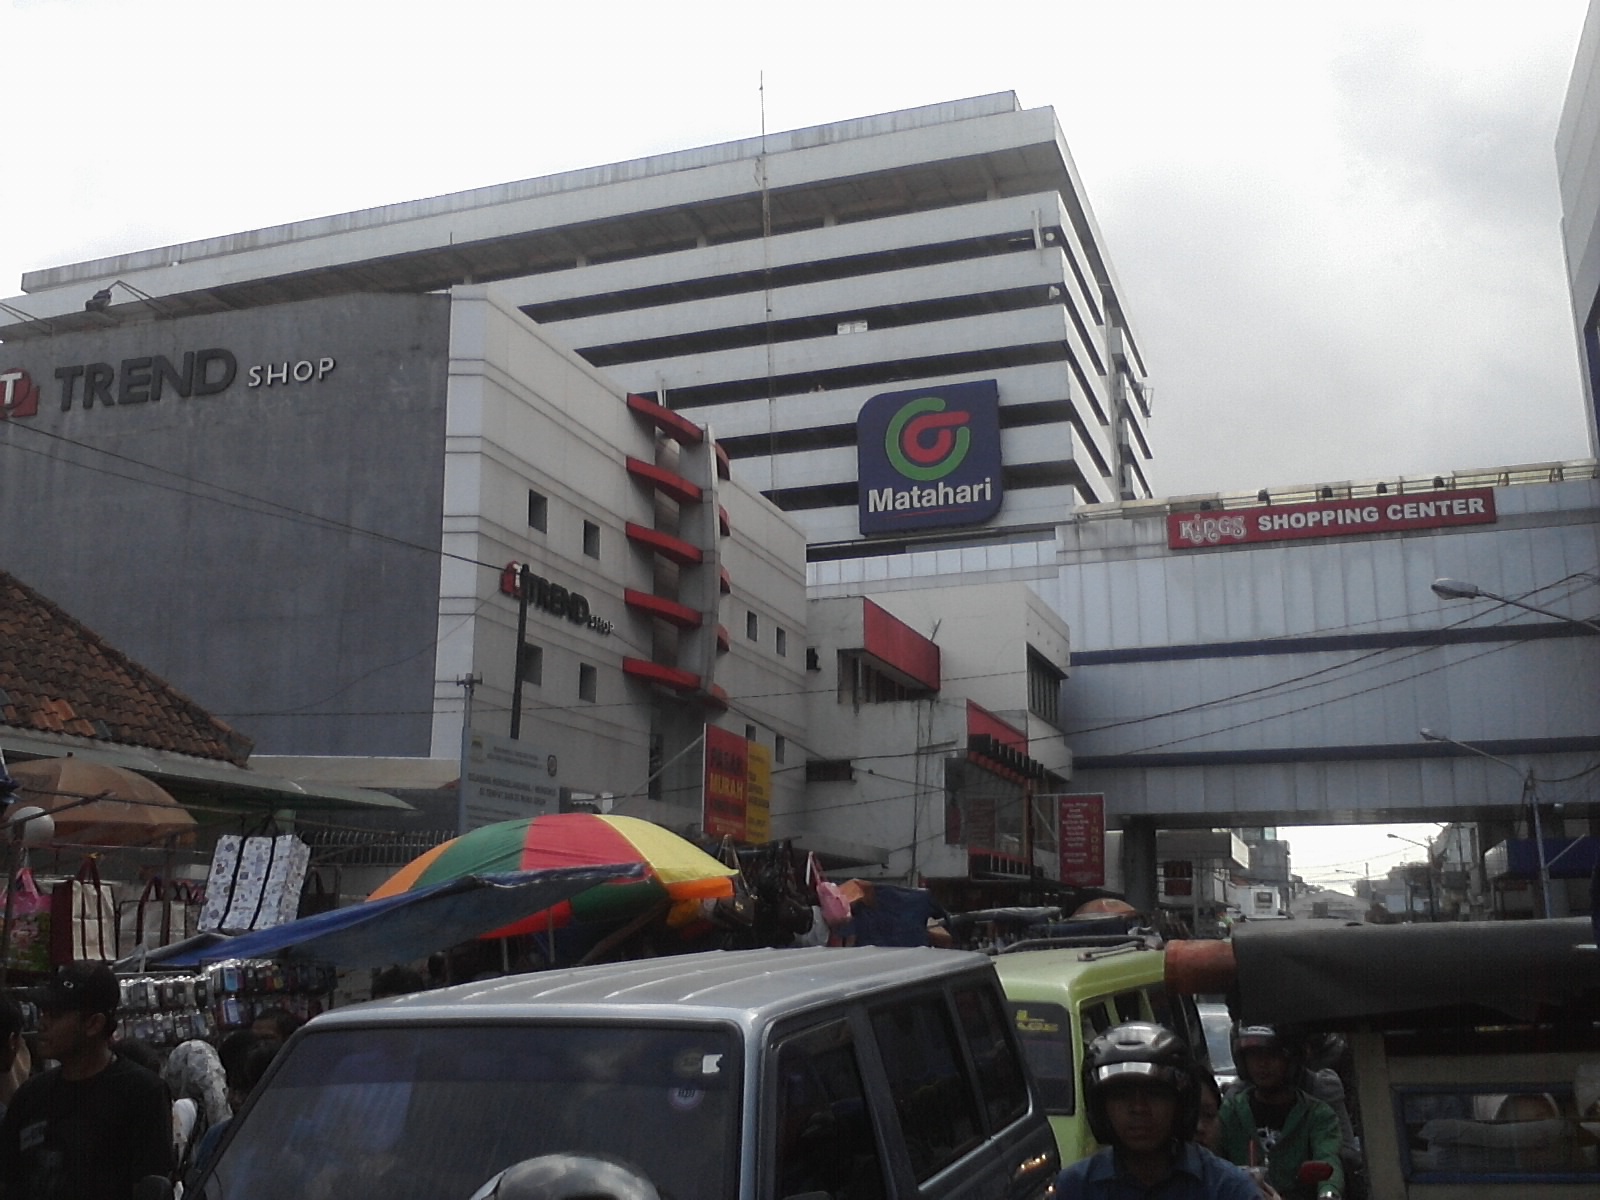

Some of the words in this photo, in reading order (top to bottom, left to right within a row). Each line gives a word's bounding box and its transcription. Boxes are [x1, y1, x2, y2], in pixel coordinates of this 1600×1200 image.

[55, 348, 237, 411] TREND
[247, 357, 336, 387] SHOP
[868, 478, 991, 513] Matahari
[1258, 506, 1379, 532] SHOPPING
[1387, 497, 1485, 520] CENTER
[710, 772, 744, 800] MURAH
